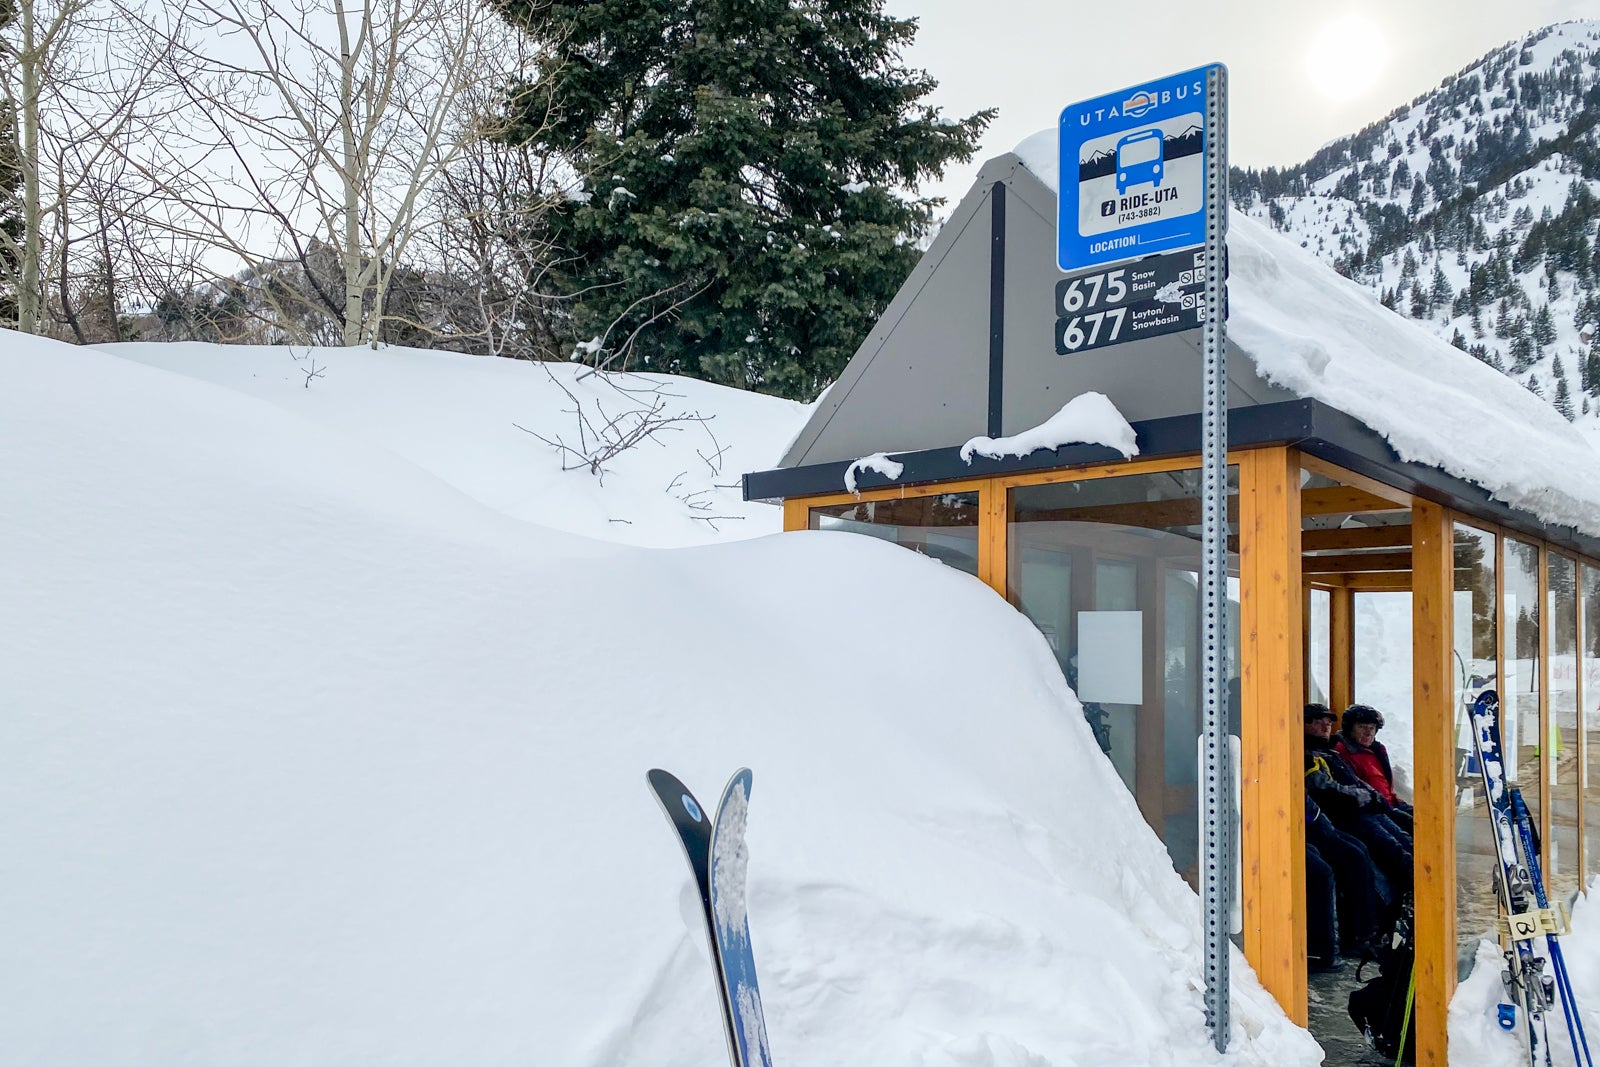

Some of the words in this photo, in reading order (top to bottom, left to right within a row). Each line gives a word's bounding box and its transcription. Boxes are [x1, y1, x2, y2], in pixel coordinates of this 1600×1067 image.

[1080, 106, 1119, 126] UTA
[1161, 81, 1202, 104] BUS
[1120, 187, 1178, 211] RIDE-UTA
[1118, 207, 1161, 224] (743-3882)
[1089, 234, 1136, 254] LOCATION
[1063, 269, 1127, 312] 675
[1131, 270, 1156, 281] Snow
[1132, 281, 1156, 292] Basin
[1063, 307, 1127, 350] 677
[1132, 305, 1165, 321] Layton/
[1132, 314, 1180, 331] Snowbasin
